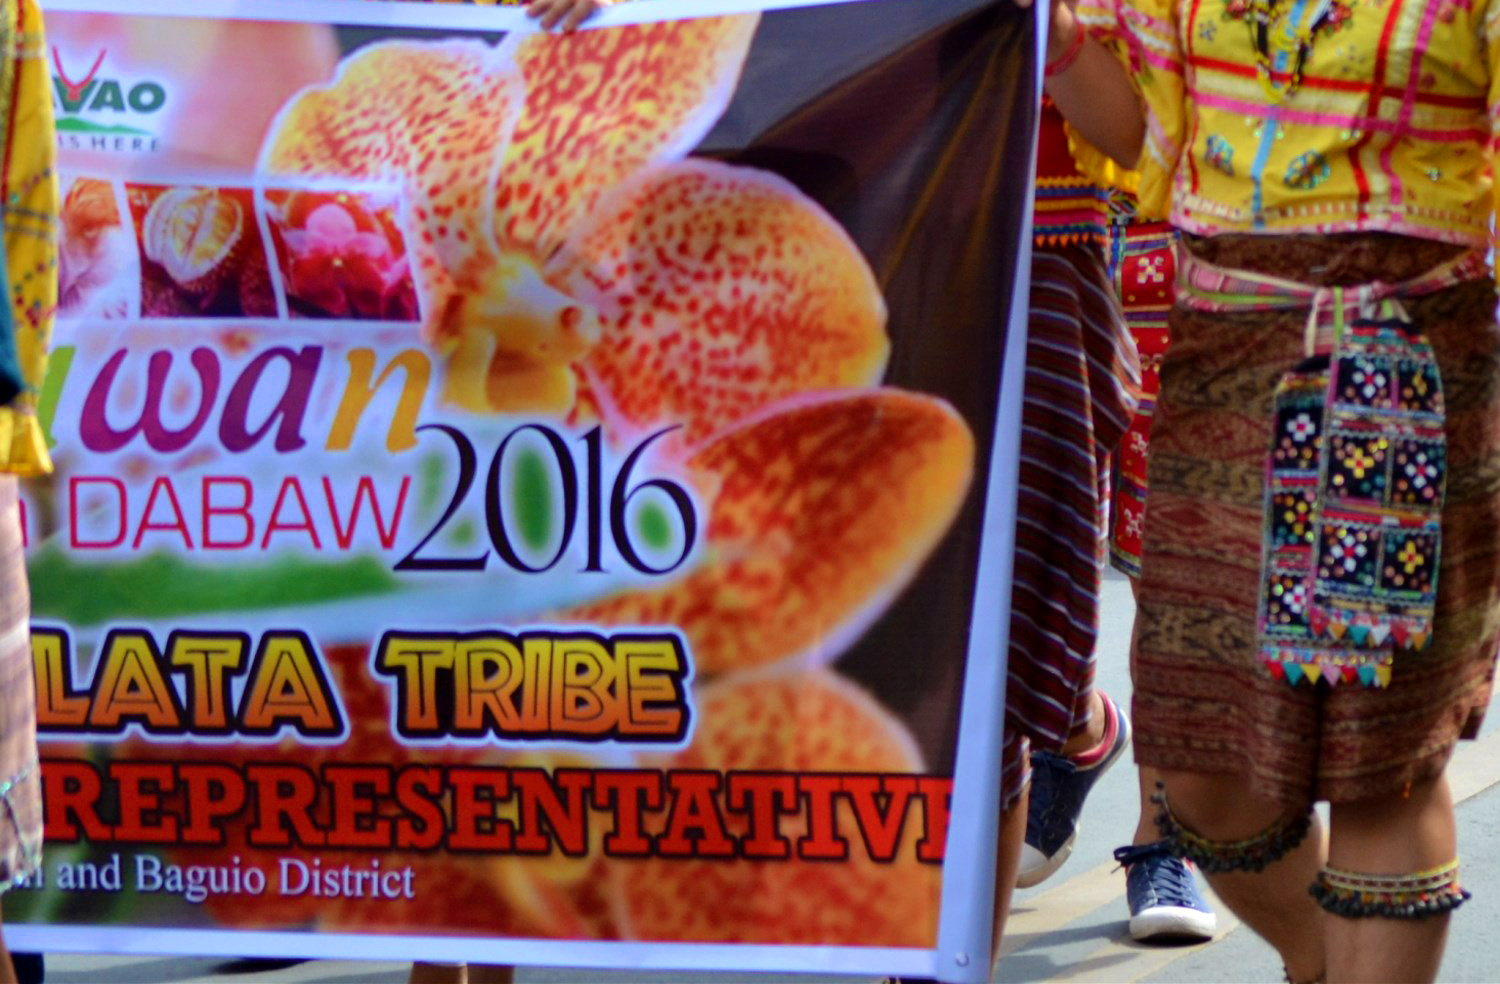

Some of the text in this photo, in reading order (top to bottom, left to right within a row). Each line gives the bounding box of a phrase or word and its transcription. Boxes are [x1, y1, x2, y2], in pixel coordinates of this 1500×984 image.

[53, 61, 166, 113] VAO
[96, 137, 160, 152] HERE
[68, 475, 411, 550] DABAW
[393, 423, 697, 575] 2016
[376, 630, 689, 742] TRIBE
[57, 854, 122, 892] and
[135, 855, 266, 903] Baguio
[279, 858, 415, 899] District
